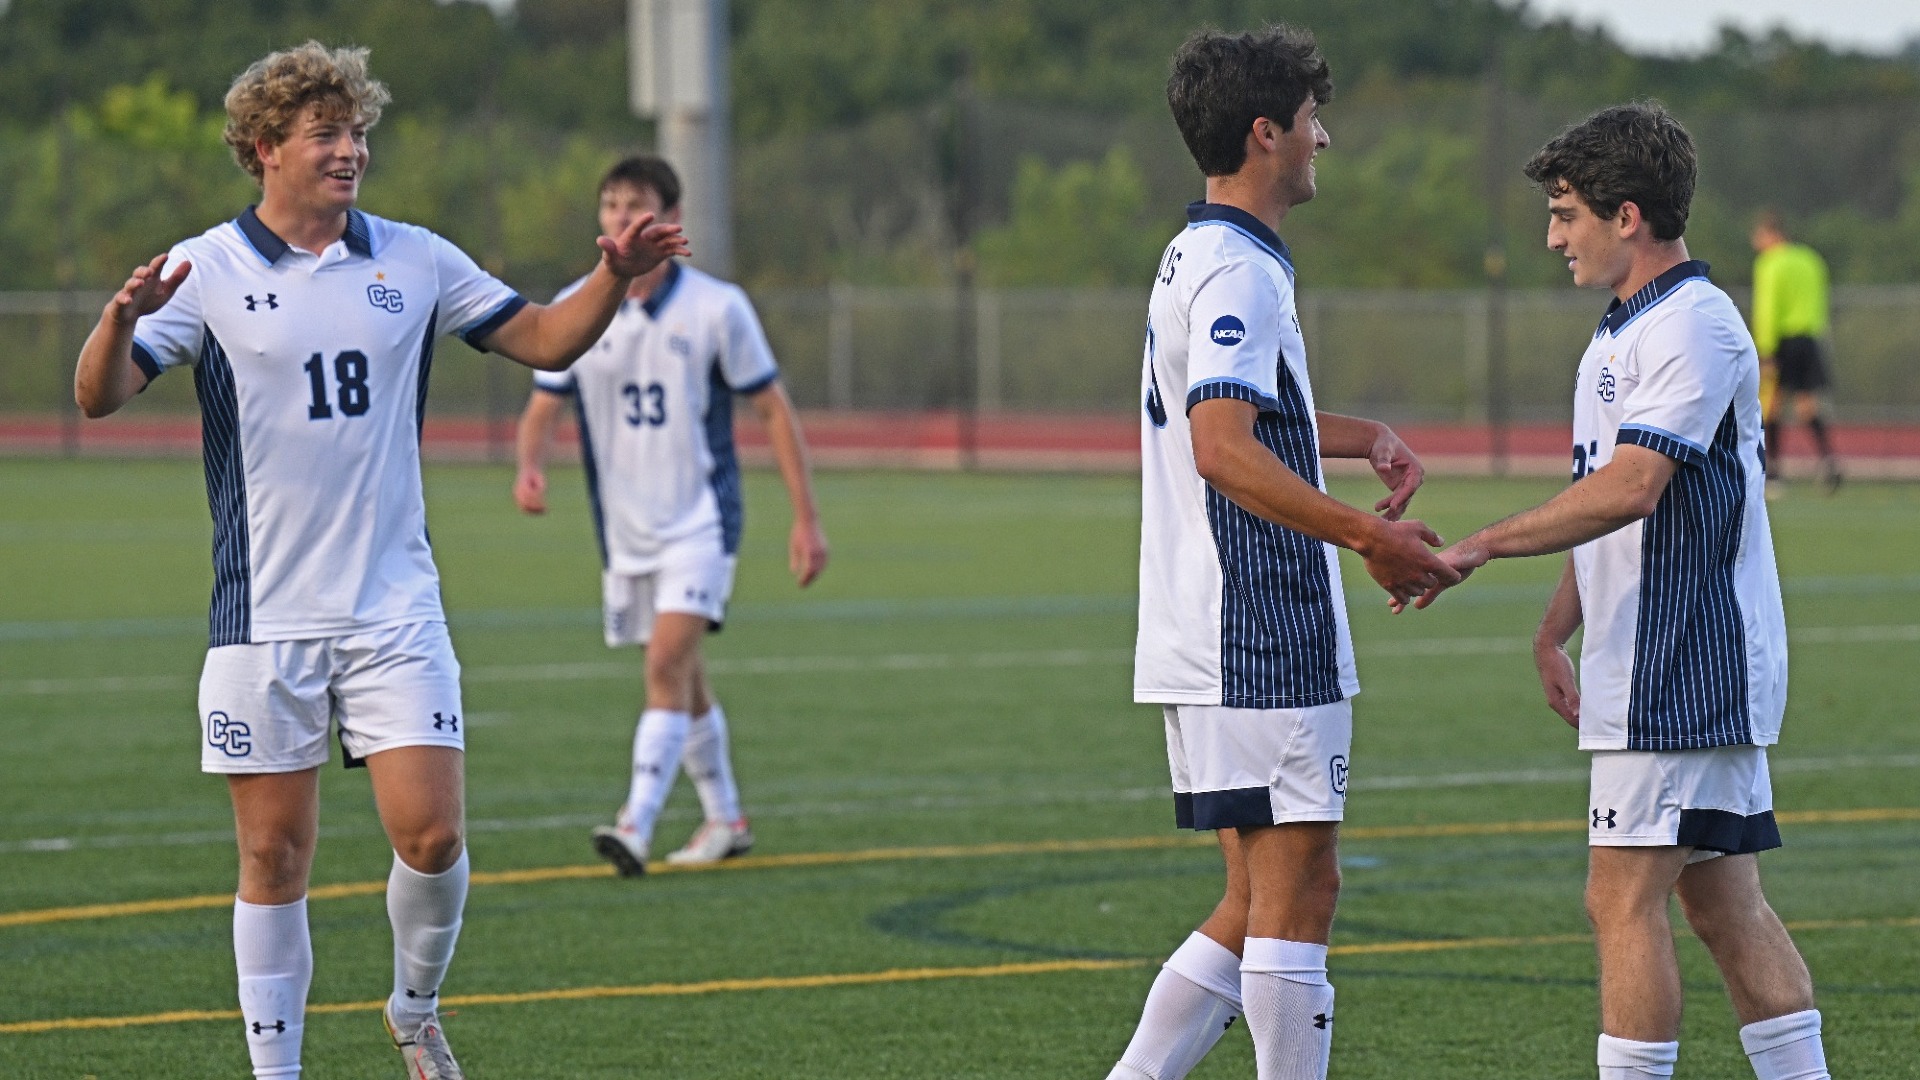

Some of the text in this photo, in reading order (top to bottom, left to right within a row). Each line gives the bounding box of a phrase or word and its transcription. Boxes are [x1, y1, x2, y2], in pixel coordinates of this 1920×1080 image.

[367, 284, 404, 314] CC
[1213, 329, 1244, 340] NCAA
[304, 349, 371, 421] 18
[622, 383, 666, 426] 33
[208, 711, 252, 758] CC
